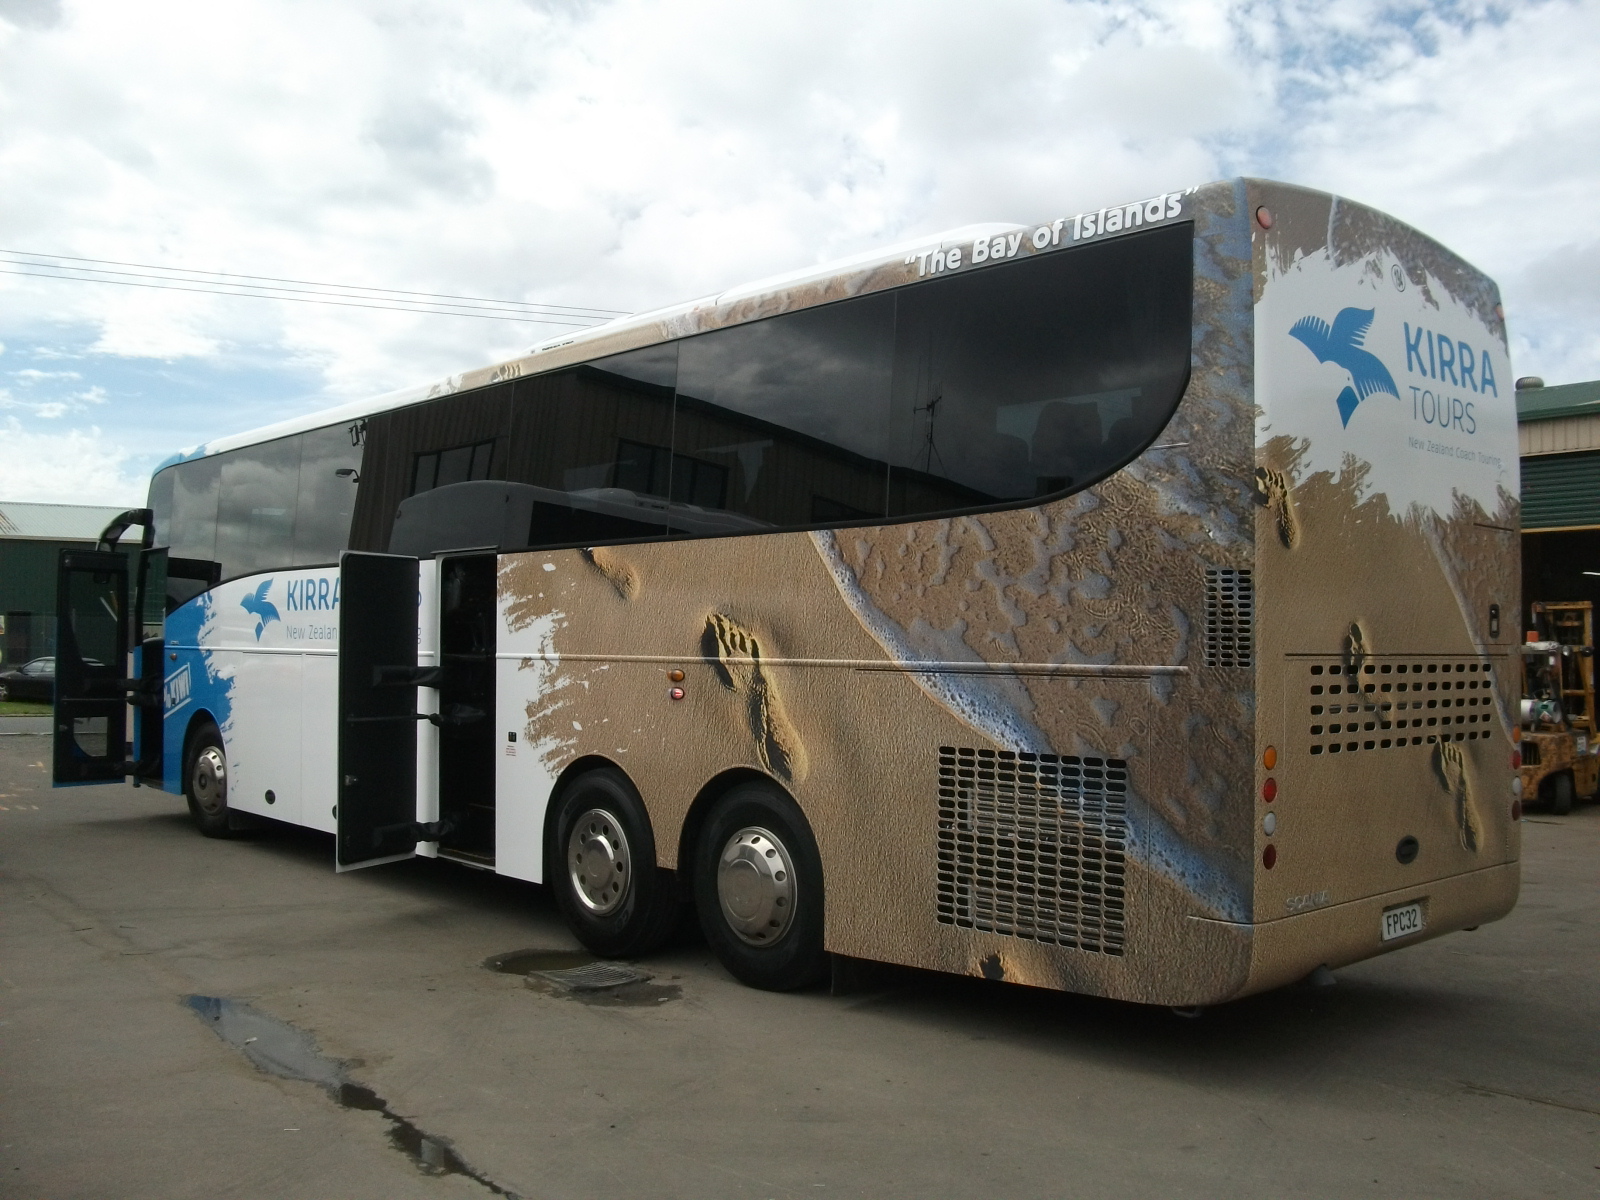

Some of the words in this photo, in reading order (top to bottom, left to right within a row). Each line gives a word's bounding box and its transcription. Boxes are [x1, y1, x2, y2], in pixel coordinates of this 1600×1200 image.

[971, 232, 1023, 264] Bay
[1032, 219, 1065, 249] of
[1403, 321, 1498, 398] KIRRA
[1408, 385, 1477, 435] TOURS
[1408, 436, 1425, 450] New
[1426, 440, 1454, 457] Zealand
[1455, 447, 1476, 461] Coach
[286, 625, 306, 640] New
[308, 625, 338, 640] Zealan
[1386, 908, 1418, 936] FPC32
